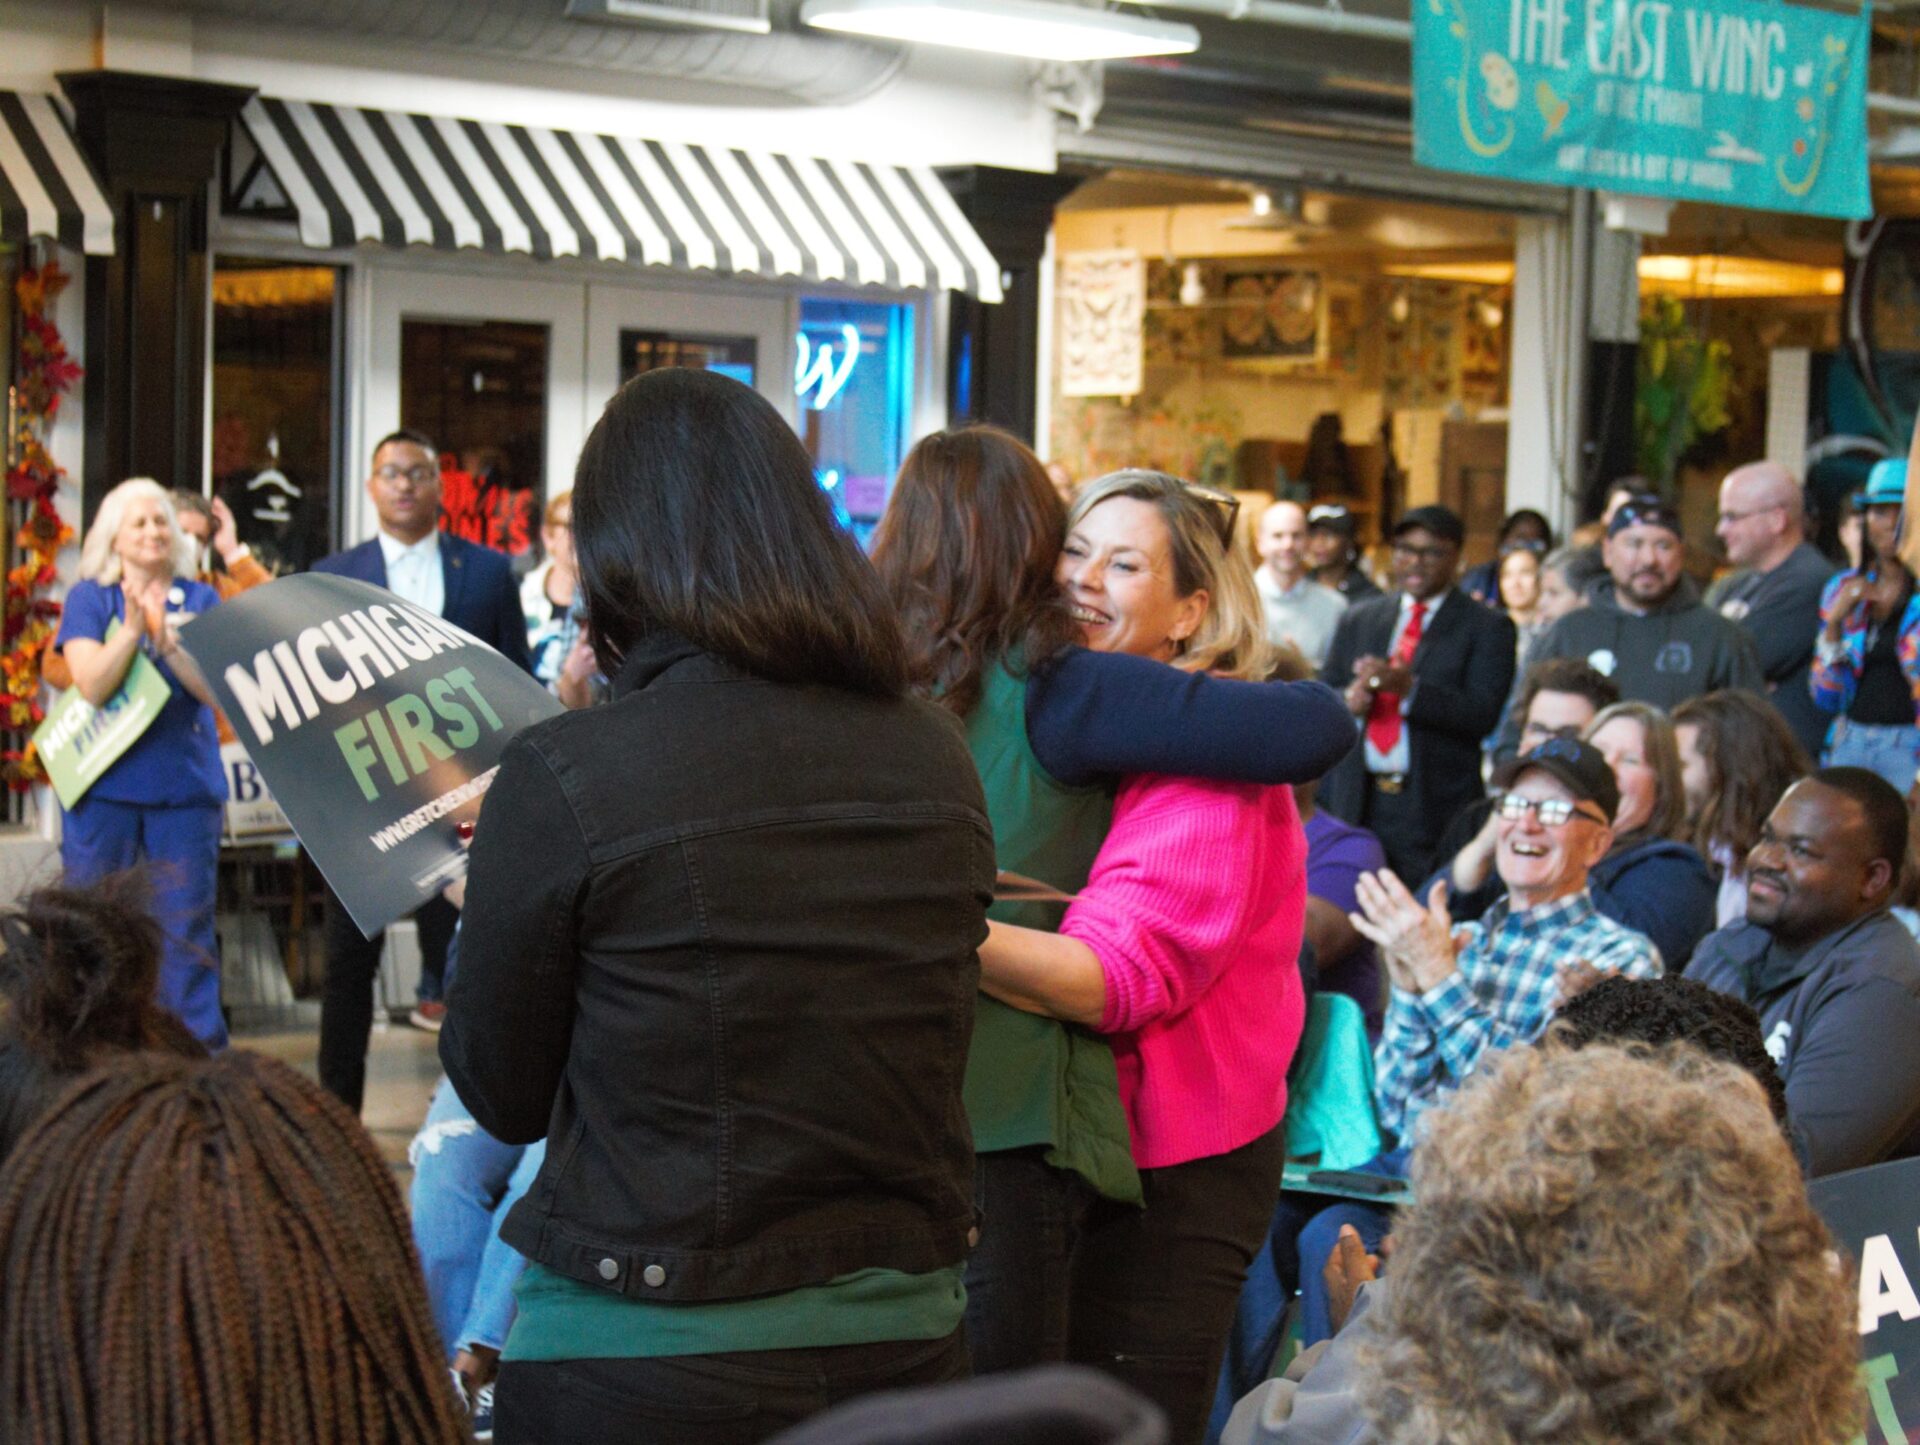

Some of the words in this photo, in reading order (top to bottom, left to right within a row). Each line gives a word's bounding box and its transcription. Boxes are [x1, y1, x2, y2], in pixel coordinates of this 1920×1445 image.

[1507, 0, 1571, 70] THE
[1584, 0, 1674, 82] EAST
[1685, 9, 1786, 101] WING
[224, 602, 502, 746] MICHIGAN
[333, 666, 504, 802] FIRST
